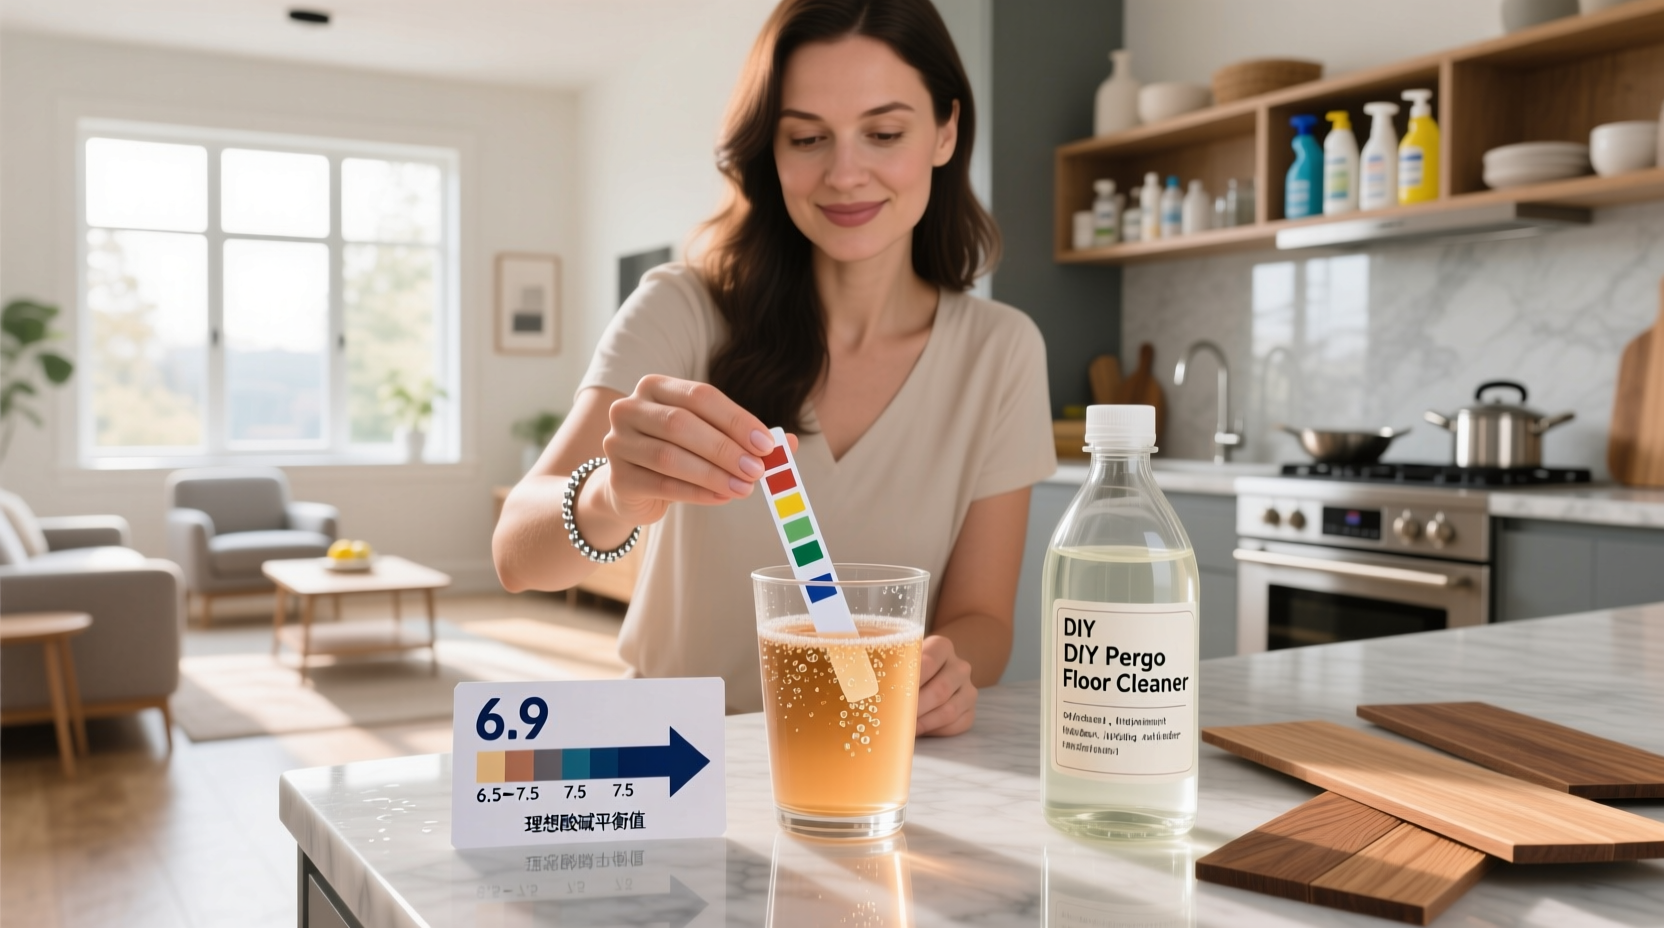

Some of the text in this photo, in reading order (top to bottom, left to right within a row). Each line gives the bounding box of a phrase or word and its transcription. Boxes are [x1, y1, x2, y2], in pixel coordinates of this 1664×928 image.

[1064, 617, 1096, 638] DIY
[1064, 643, 1166, 672] DIY Pergo
[1063, 668, 1189, 693] Floor Cleaner
[476, 696, 549, 741] 6.9
[564, 784, 586, 799] 7.5
[613, 783, 634, 797] 7.5
